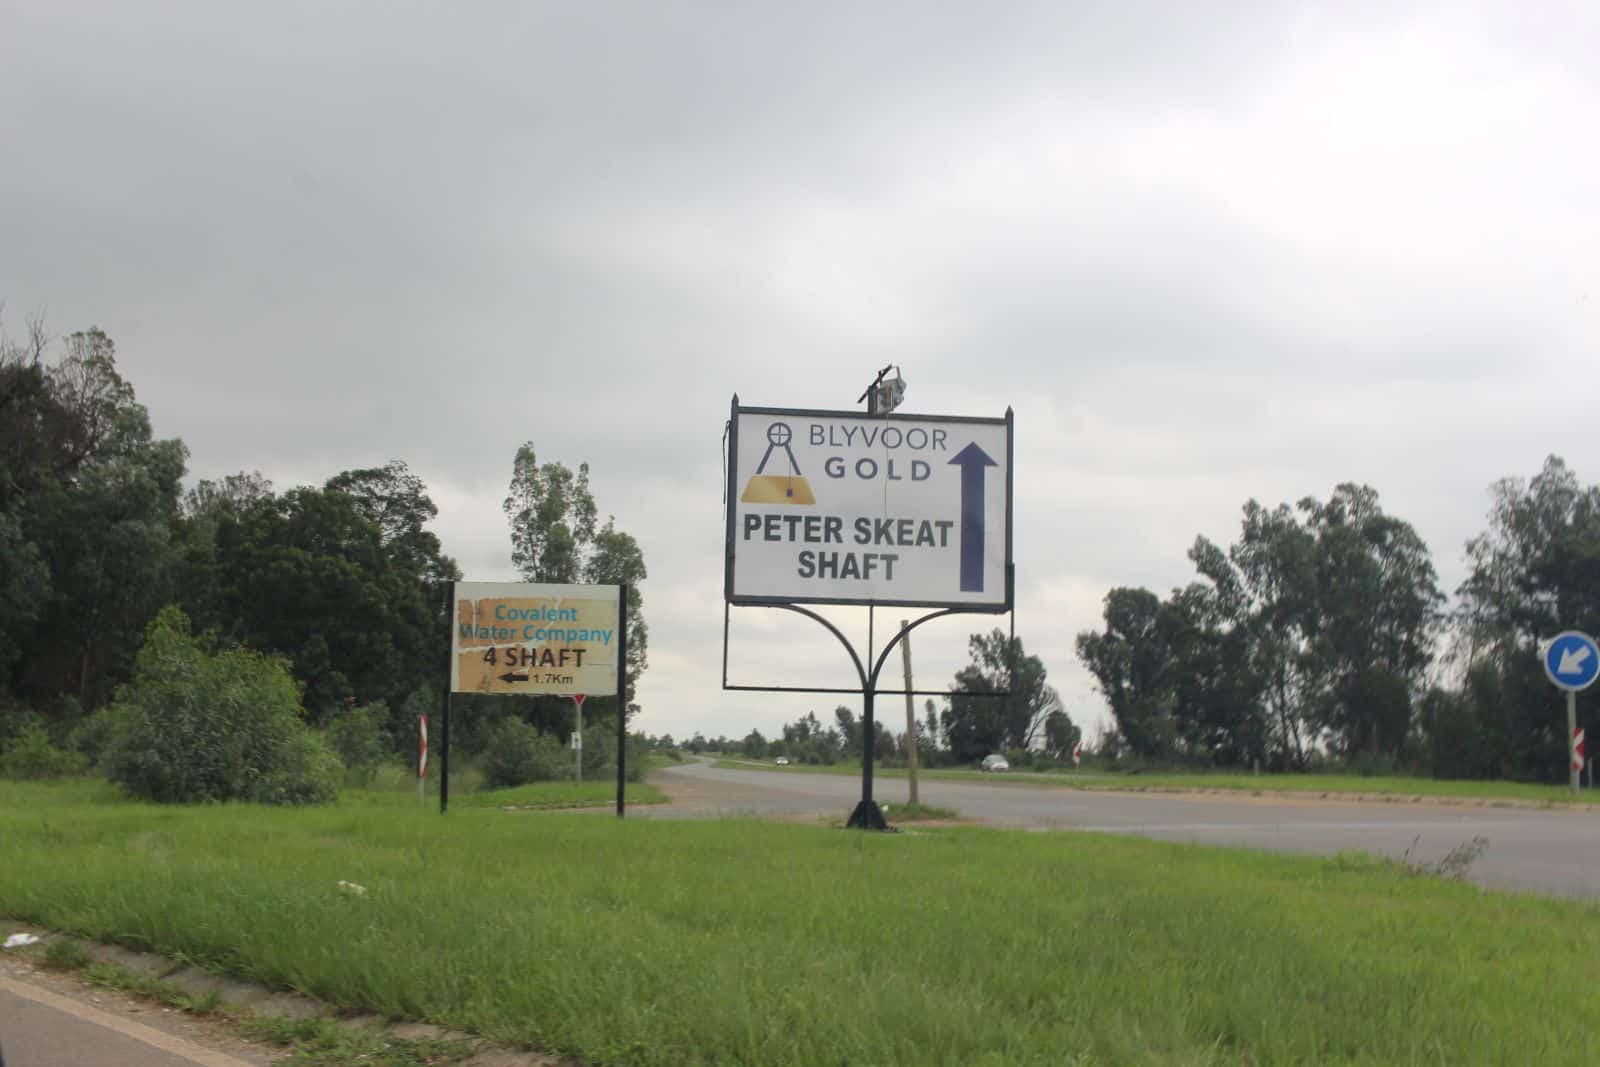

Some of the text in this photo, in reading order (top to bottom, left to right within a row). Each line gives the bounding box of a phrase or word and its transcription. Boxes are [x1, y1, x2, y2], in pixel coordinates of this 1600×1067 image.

[810, 424, 948, 451] BLYVOOR
[824, 456, 931, 481] GOLD
[743, 513, 954, 547] PETER SKEAT
[797, 550, 899, 581] SHAFT
[495, 604, 577, 621] Covalent
[460, 624, 613, 646] Water Company
[483, 647, 587, 667] 4 SHAFT
[533, 673, 573, 685] 1.7Km
